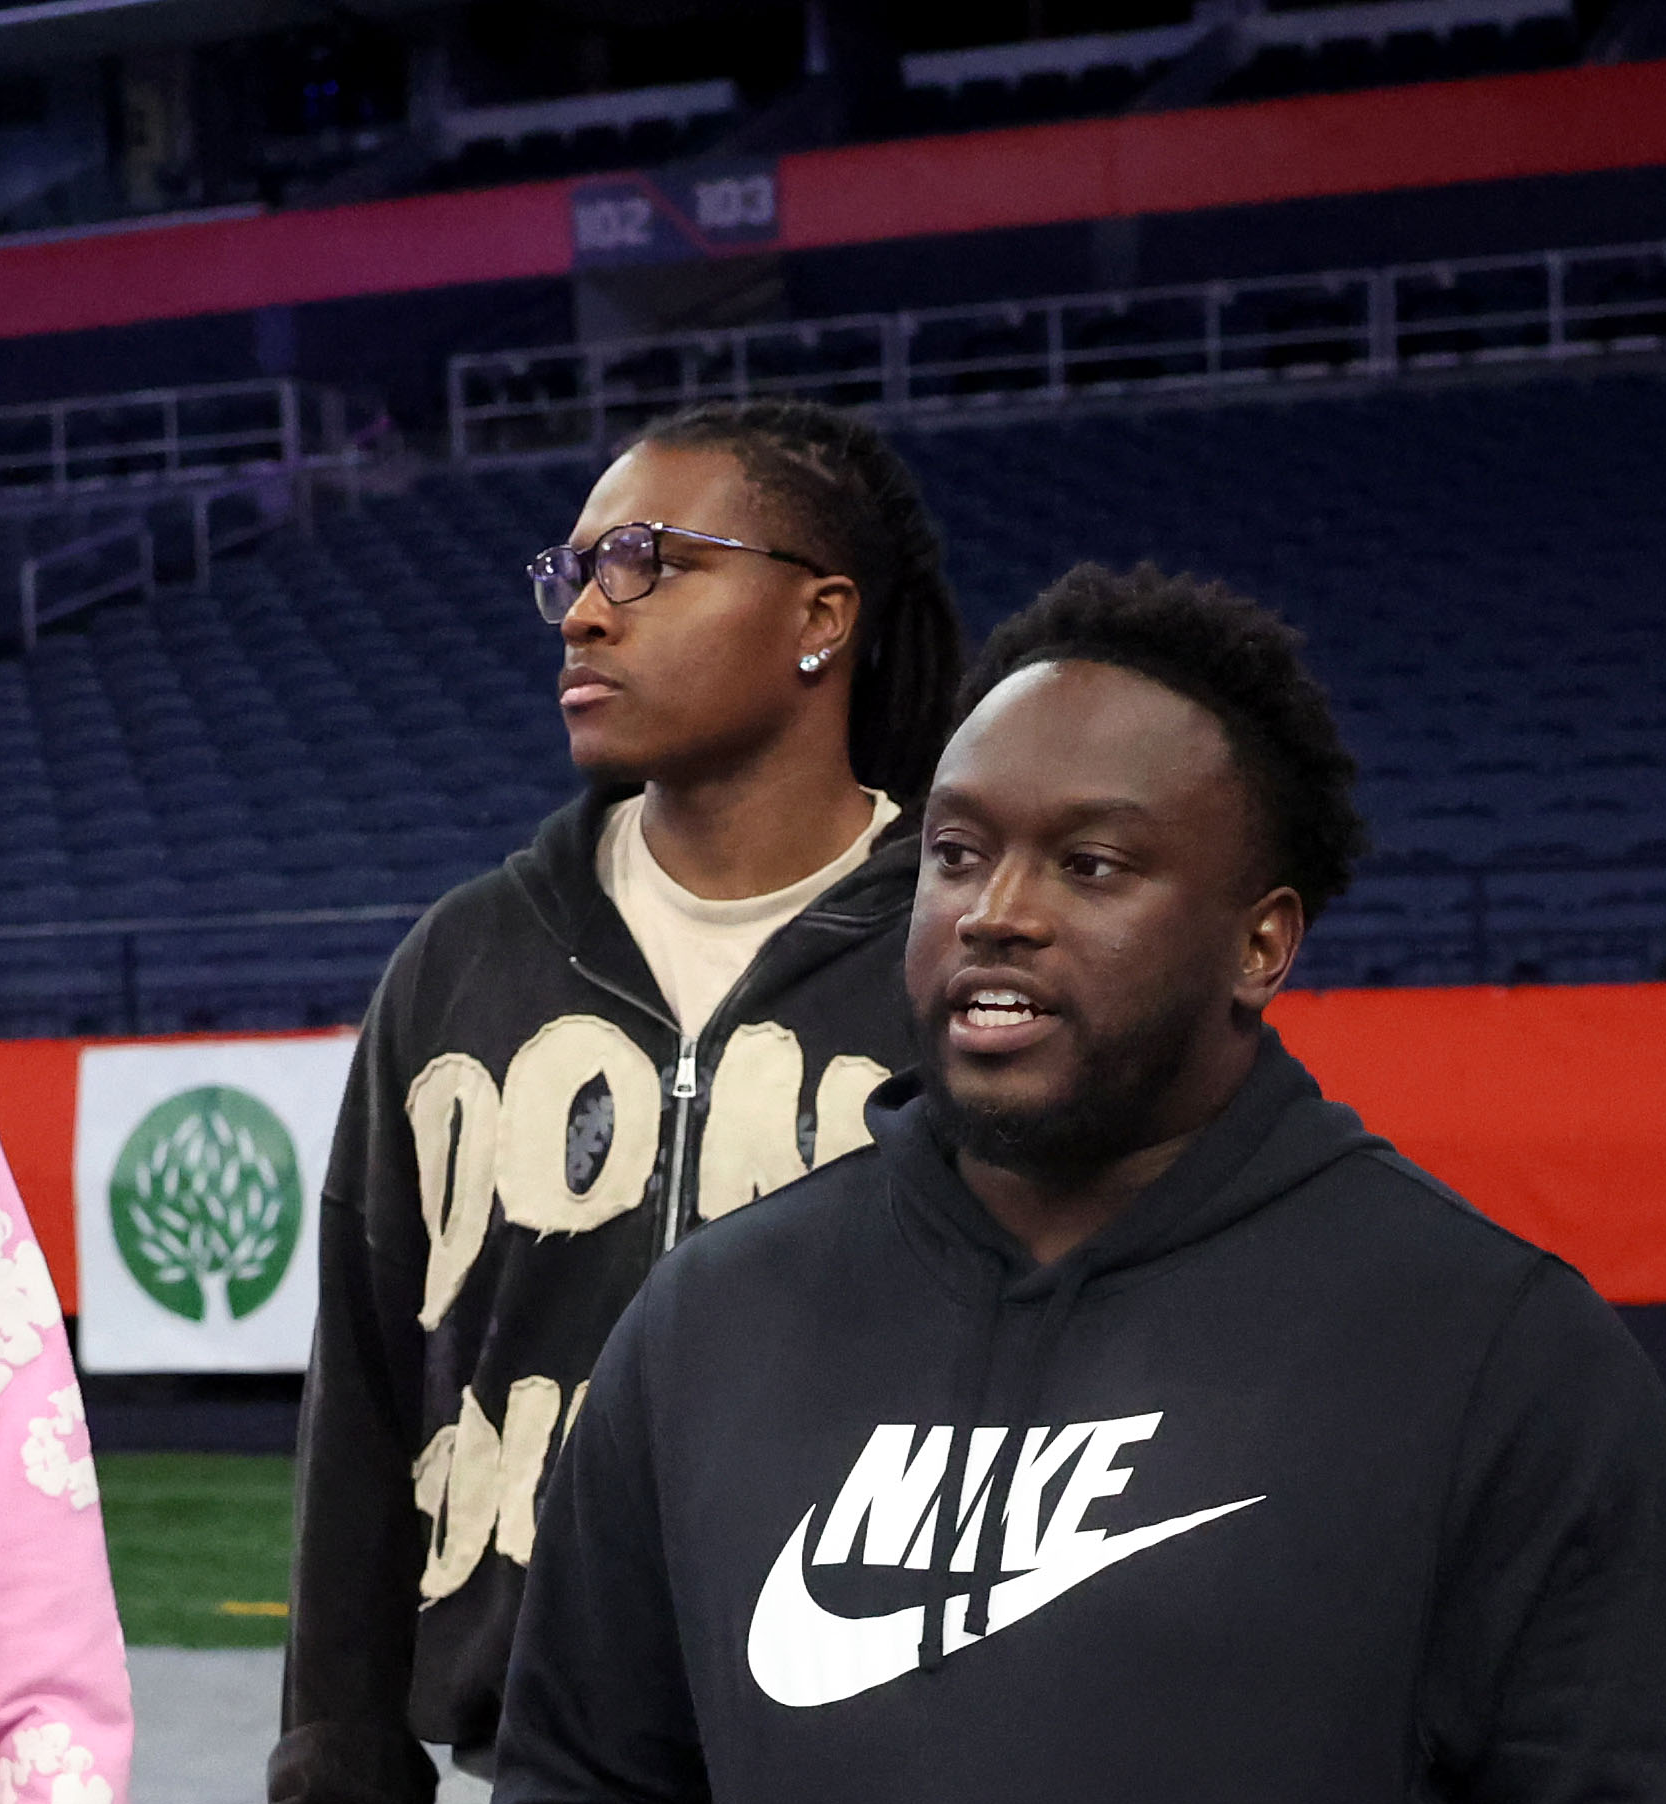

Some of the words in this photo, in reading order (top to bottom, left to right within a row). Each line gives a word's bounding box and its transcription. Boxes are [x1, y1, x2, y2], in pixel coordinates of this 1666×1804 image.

[575, 197, 654, 249] 102
[694, 174, 775, 229] 103
[813, 1411, 1164, 1572] NIKE
